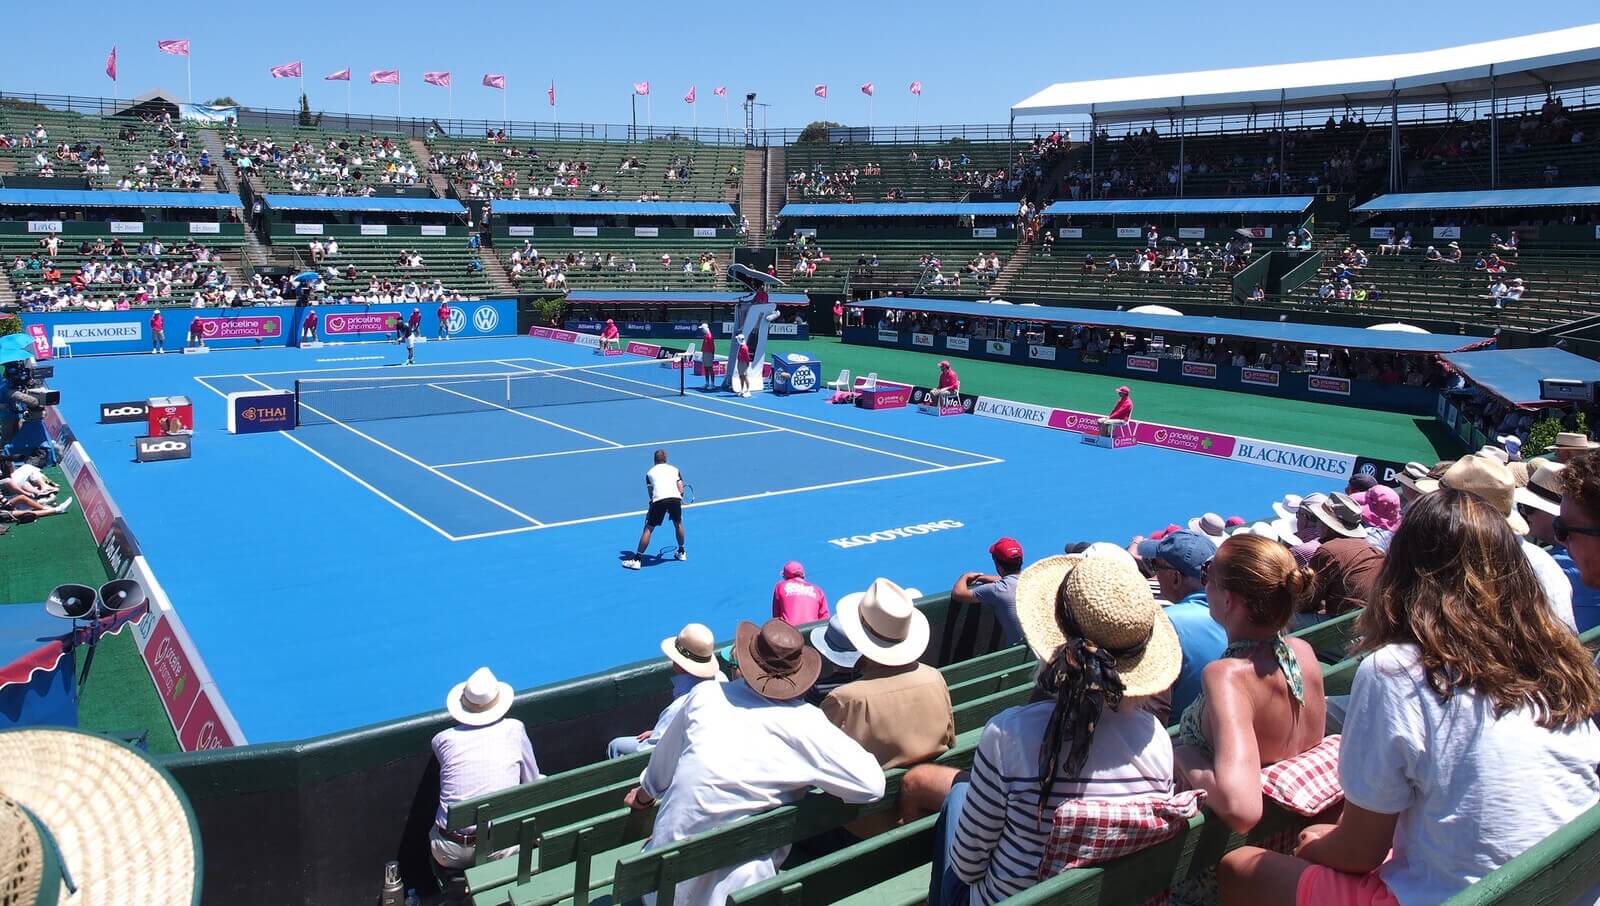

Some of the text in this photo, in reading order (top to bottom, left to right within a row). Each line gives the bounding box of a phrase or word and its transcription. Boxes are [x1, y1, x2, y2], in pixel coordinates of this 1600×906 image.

[221, 320, 259, 329] priceline
[347, 316, 381, 325] priceline
[57, 327, 137, 338] BLACKMORES
[221, 327, 260, 336] pharmacy
[347, 323, 382, 331] pharmacy
[796, 368, 811, 376] cool
[793, 375, 815, 387] Ridge
[257, 407, 286, 417] THAI
[977, 401, 1045, 423] BLACKMORES
[1169, 431, 1200, 442] priceline
[1167, 438, 1198, 449] pharmacy
[1238, 443, 1348, 475] BLACKMORES
[827, 519, 965, 549] KOOYONG
